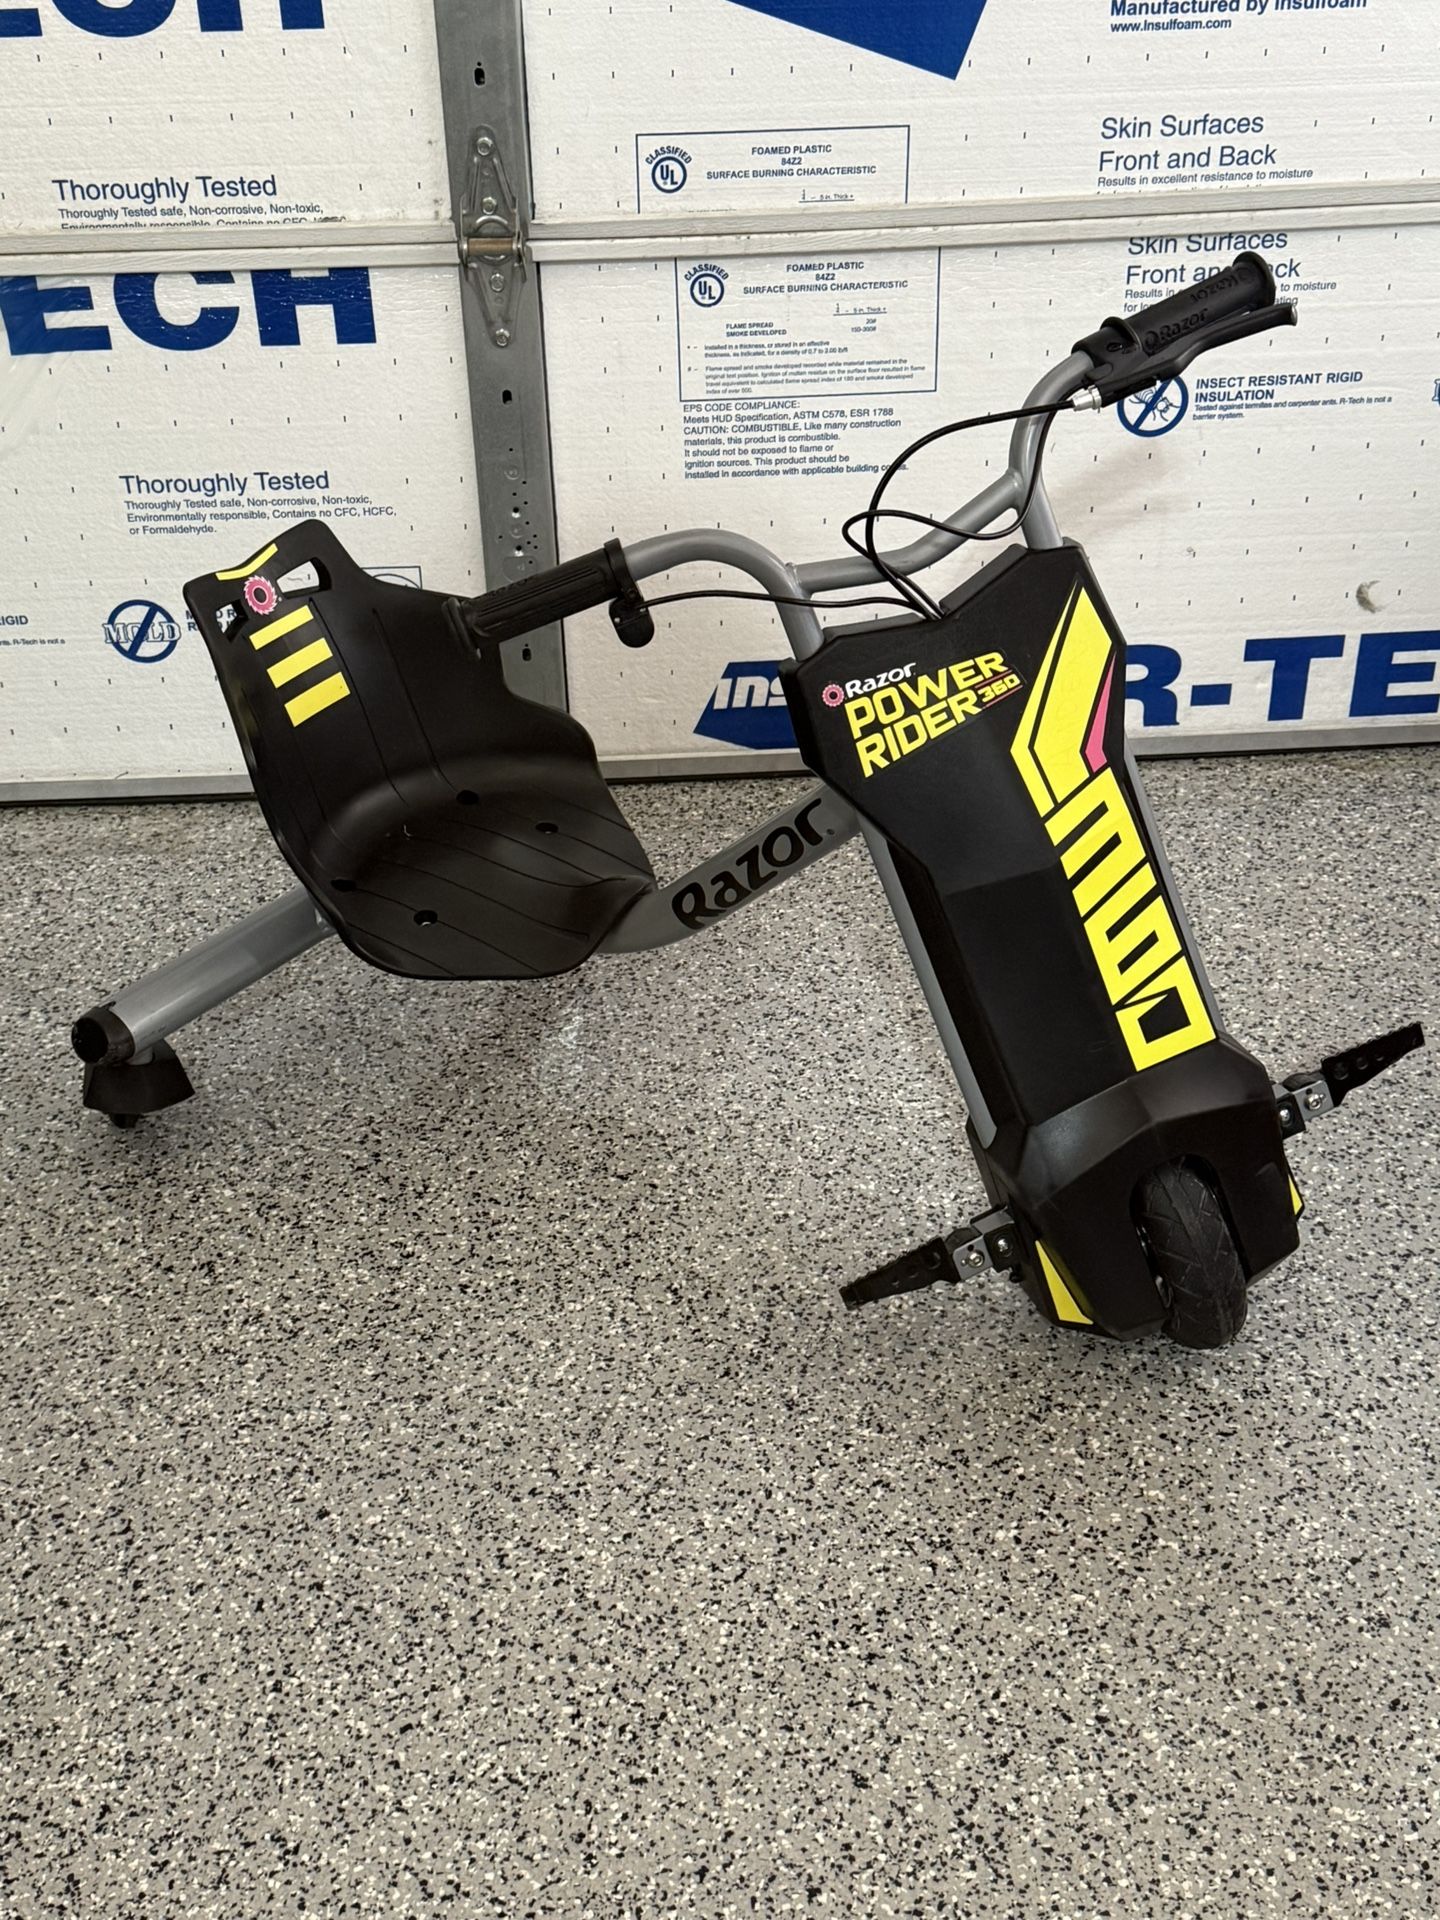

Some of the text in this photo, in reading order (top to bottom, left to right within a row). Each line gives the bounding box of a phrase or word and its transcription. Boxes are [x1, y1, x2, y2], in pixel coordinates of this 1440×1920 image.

[1110, 0, 1240, 16] Manufactured
[1246, 0, 1267, 15] by
[1110, 18, 1232, 32] www.Insulfoam.com
[1101, 113, 1264, 139] Skin Surfaces
[645, 145, 693, 165] CLASSIFIED
[751, 144, 832, 155] FOAMED PLASTIC
[1099, 144, 1277, 172] Front and Back
[781, 157, 802, 166] 84Z2
[660, 164, 678, 185] UL
[706, 165, 876, 179] SURFACE BURNING CHARACTERISTIC
[1097, 169, 1314, 187] Results in excellent resistance to moisture
[51, 174, 277, 204] Thoroughly Tested
[58, 202, 324, 221] Thoroughly Tested safe, Non-corrosive, Non-toxic,
[1128, 232, 1288, 255] Skin Surfaces
[684, 263, 729, 281] CLASSIFIED
[786, 261, 864, 272] FOAMED PLASTIC
[1126, 264, 1186, 285] Front
[1193, 266, 1221, 281] an
[815, 273, 836, 281] 84Z2
[698, 280, 716, 300] UL
[743, 280, 908, 295] SURFACE BURNING CHARACTERISTIC
[1125, 289, 1163, 299] Results
[1280, 283, 1290, 292] to
[1293, 281, 1337, 291] moisture
[1123, 303, 1137, 312] for
[1160, 308, 1208, 340] Razor
[1196, 371, 1363, 389] INSECT RESISTANT RIGID
[1195, 389, 1274, 403] INSULATION
[683, 400, 800, 412] EPS CODE COMPLIANCE:
[1218, 402, 1244, 411] against
[1273, 400, 1287, 408] and
[1288, 399, 1321, 408] carpenter
[683, 415, 709, 424] Meets
[711, 414, 732, 423] HUD
[735, 411, 792, 423] Specification,
[793, 410, 819, 419] ASTM
[850, 408, 870, 417] ESR
[873, 408, 894, 416] 1788
[683, 419, 901, 435] CAUTION: COMBUSTIBLE, Like many construction
[684, 433, 840, 446] materials, this product is combustible.
[692, 448, 720, 457] should
[722, 447, 736, 456] not
[738, 447, 749, 455] be
[751, 446, 787, 457] exposed
[789, 445, 797, 453] to
[799, 444, 822, 453] flame
[684, 454, 850, 470] ignition sources. This product should be
[721, 469, 729, 478] in
[731, 468, 780, 478] accordance
[782, 467, 799, 476] with
[801, 465, 844, 476] applicable
[846, 464, 879, 474] building
[119, 470, 329, 497] Thoroughly Tested
[124, 494, 372, 511] Thoroughly Tested safe, Non-corrosive, Non-toxic,
[127, 506, 397, 523] Environmentally responsible, Contains no CFC, HCFC,
[129, 524, 217, 536] or Formaldehyde.
[0, 615, 29, 626] IGID
[845, 662, 916, 698] Razor
[844, 652, 1009, 740] POWER
[856, 673, 1021, 778] RIDER 360
[672, 798, 824, 930] Razor
